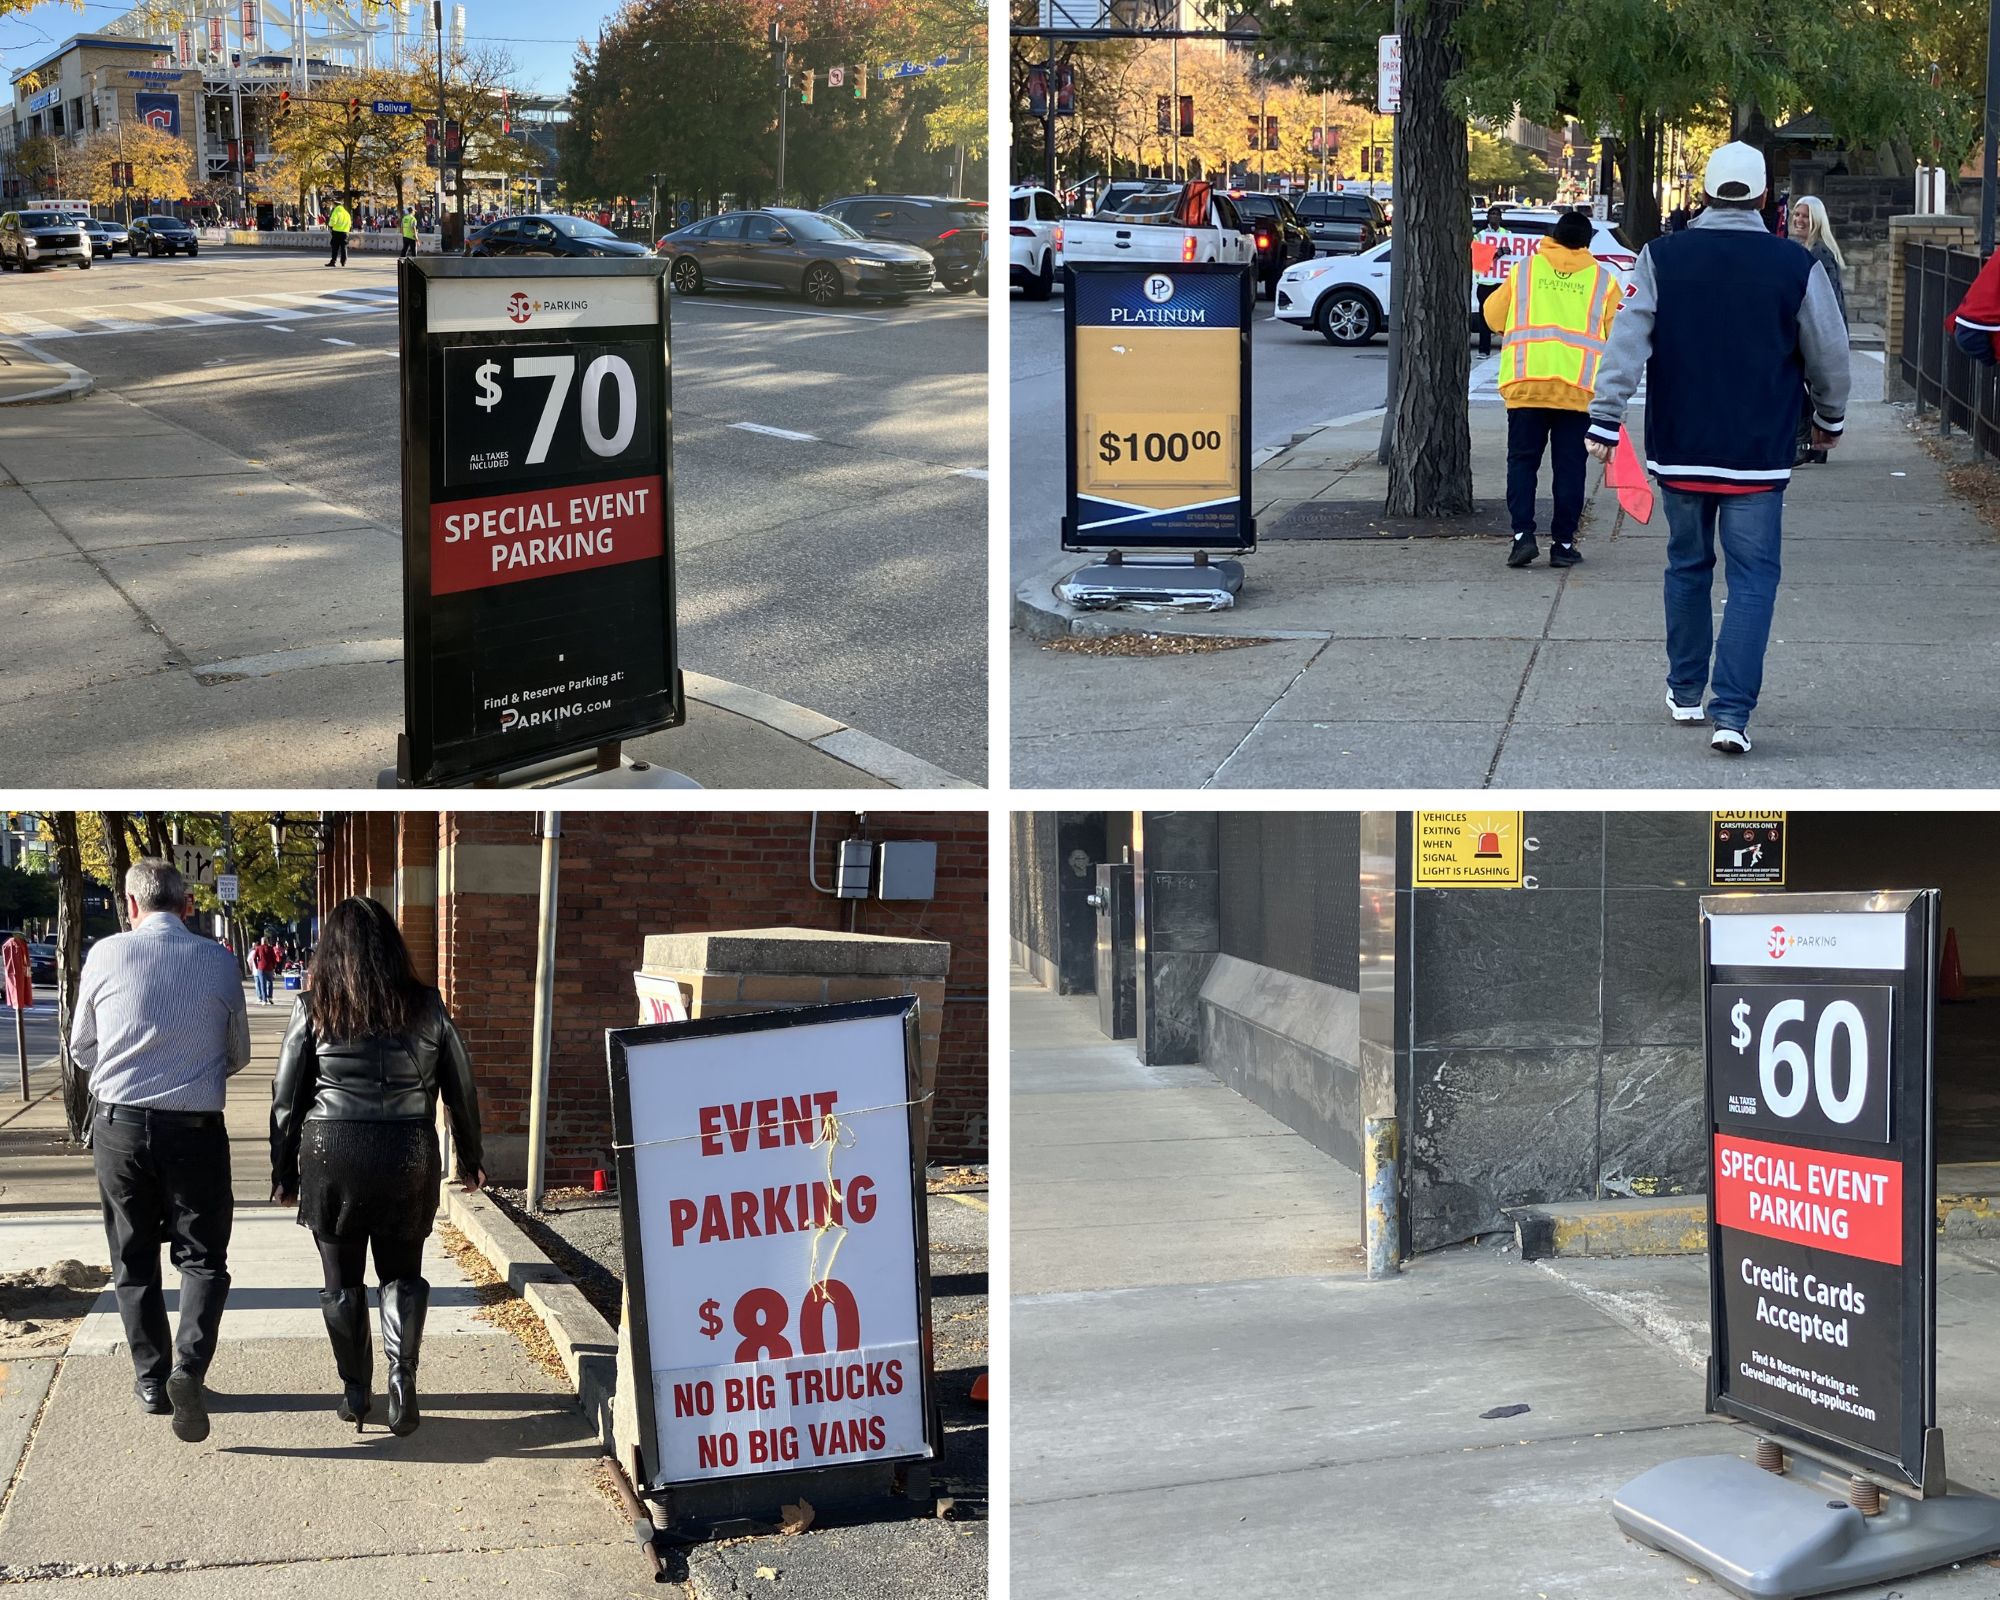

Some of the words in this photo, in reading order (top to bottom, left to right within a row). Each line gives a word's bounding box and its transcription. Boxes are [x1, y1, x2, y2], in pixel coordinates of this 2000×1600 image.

[377, 103, 407, 112] Bolivar
[1538, 278, 1585, 291] PLATINUM
[543, 300, 588, 311] PARKING
[1110, 308, 1206, 323] PLATINUM
[475, 354, 638, 465] $70
[469, 459, 509, 471] INCLUDED
[470, 453, 485, 462] ALL
[486, 451, 509, 461] TAXES
[444, 502, 562, 543] SPECIAL
[569, 489, 649, 525] EVENT
[491, 527, 614, 572] PARKING
[484, 696, 508, 710] Find
[511, 693, 519, 704] &
[522, 683, 566, 702] Reserve
[568, 672, 609, 691] Parking
[610, 671, 625, 682] at:
[1423, 813, 1467, 822] VEHICLES
[1423, 826, 1461, 835] EXITING
[1423, 840, 1453, 848] WHEN
[1423, 853, 1458, 862] SIGNAL
[1423, 867, 1451, 875] LIGHT
[1453, 867, 1462, 875] IS
[1463, 867, 1510, 876] FLASHING
[1797, 936, 1837, 947] PARKING
[1731, 997, 1869, 1124] $60
[1728, 1095, 1739, 1104] ALL
[1739, 1096, 1757, 1106] TAXES
[1728, 1104, 1757, 1115] INCLUDED
[699, 1090, 838, 1157] EVENT
[1721, 1148, 1801, 1192] SPECIAL
[1807, 1164, 1889, 1206] EVENT
[669, 1174, 877, 1247] PARKING
[1749, 1191, 1849, 1240] PARKING
[1741, 1257, 1799, 1298] Credit
[1803, 1275, 1865, 1315] Cards
[1756, 1296, 1849, 1348] Accepted
[674, 1380, 715, 1418] NO
[725, 1374, 776, 1413] BIG
[786, 1359, 903, 1406] TRUCKS
[1740, 1362, 1876, 1421] ClevelandParking.spplus.com
[1752, 1350, 1768, 1367] Find
[1769, 1356, 1776, 1369] &
[1777, 1359, 1810, 1381] Reserve
[1811, 1370, 1845, 1394] Parking
[1846, 1381, 1859, 1398] at:
[697, 1432, 739, 1469] NO
[749, 1426, 799, 1464] BIG
[808, 1415, 886, 1457] VANS
